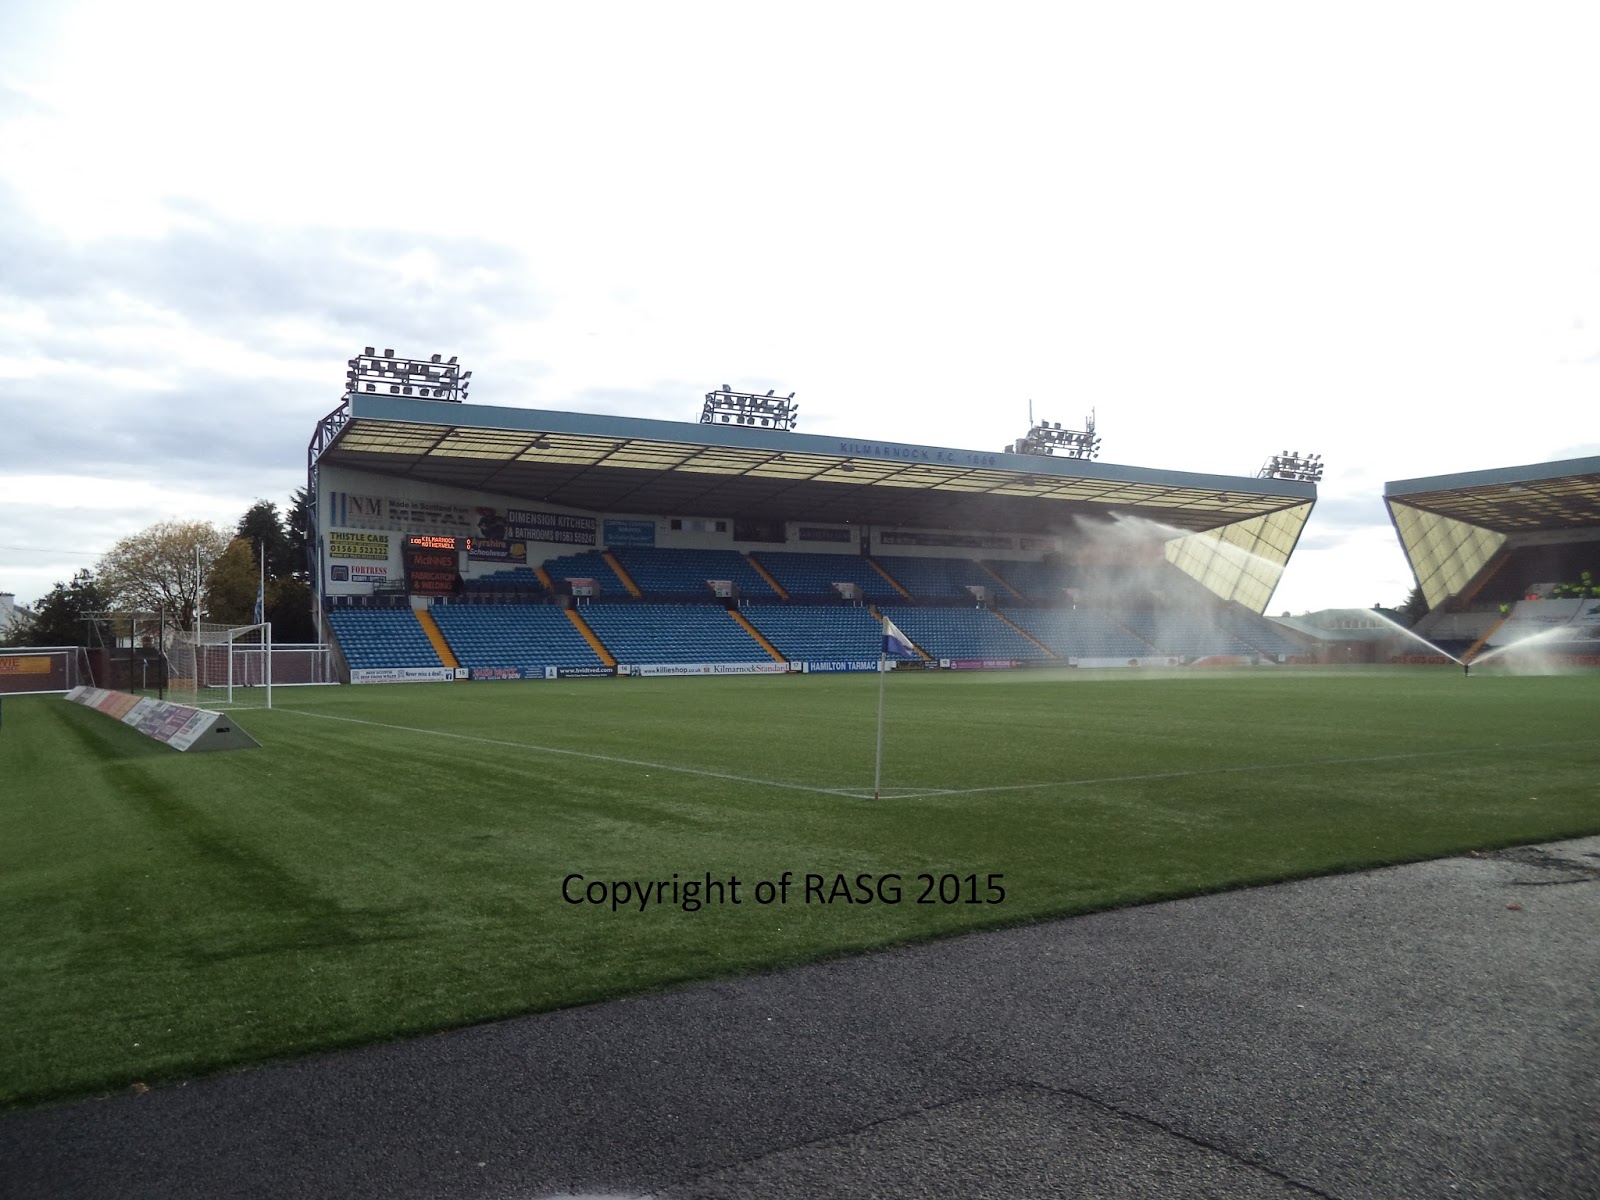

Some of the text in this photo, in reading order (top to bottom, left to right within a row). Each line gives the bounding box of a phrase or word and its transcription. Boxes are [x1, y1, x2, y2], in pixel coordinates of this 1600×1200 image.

[840, 442, 929, 460] KILMARNOCK
[388, 500, 409, 508] Made
[420, 502, 452, 512] Scotland
[388, 508, 471, 526] METAL
[508, 511, 596, 530] DIMENSION KITCHENS
[330, 532, 389, 543] THISTLE CABS
[508, 526, 514, 538] &
[515, 527, 554, 541] BATHROOMS
[555, 530, 574, 543] 01563
[330, 545, 357, 553] 01563
[471, 538, 507, 549] Ayrshire
[469, 548, 508, 557] Schoolwear
[414, 555, 452, 566] McINNES
[351, 565, 388, 575] FORTRESS
[410, 571, 456, 581] FABRICATION
[421, 581, 453, 589] WELDING
[810, 661, 876, 671] HAMILTON TARMAC
